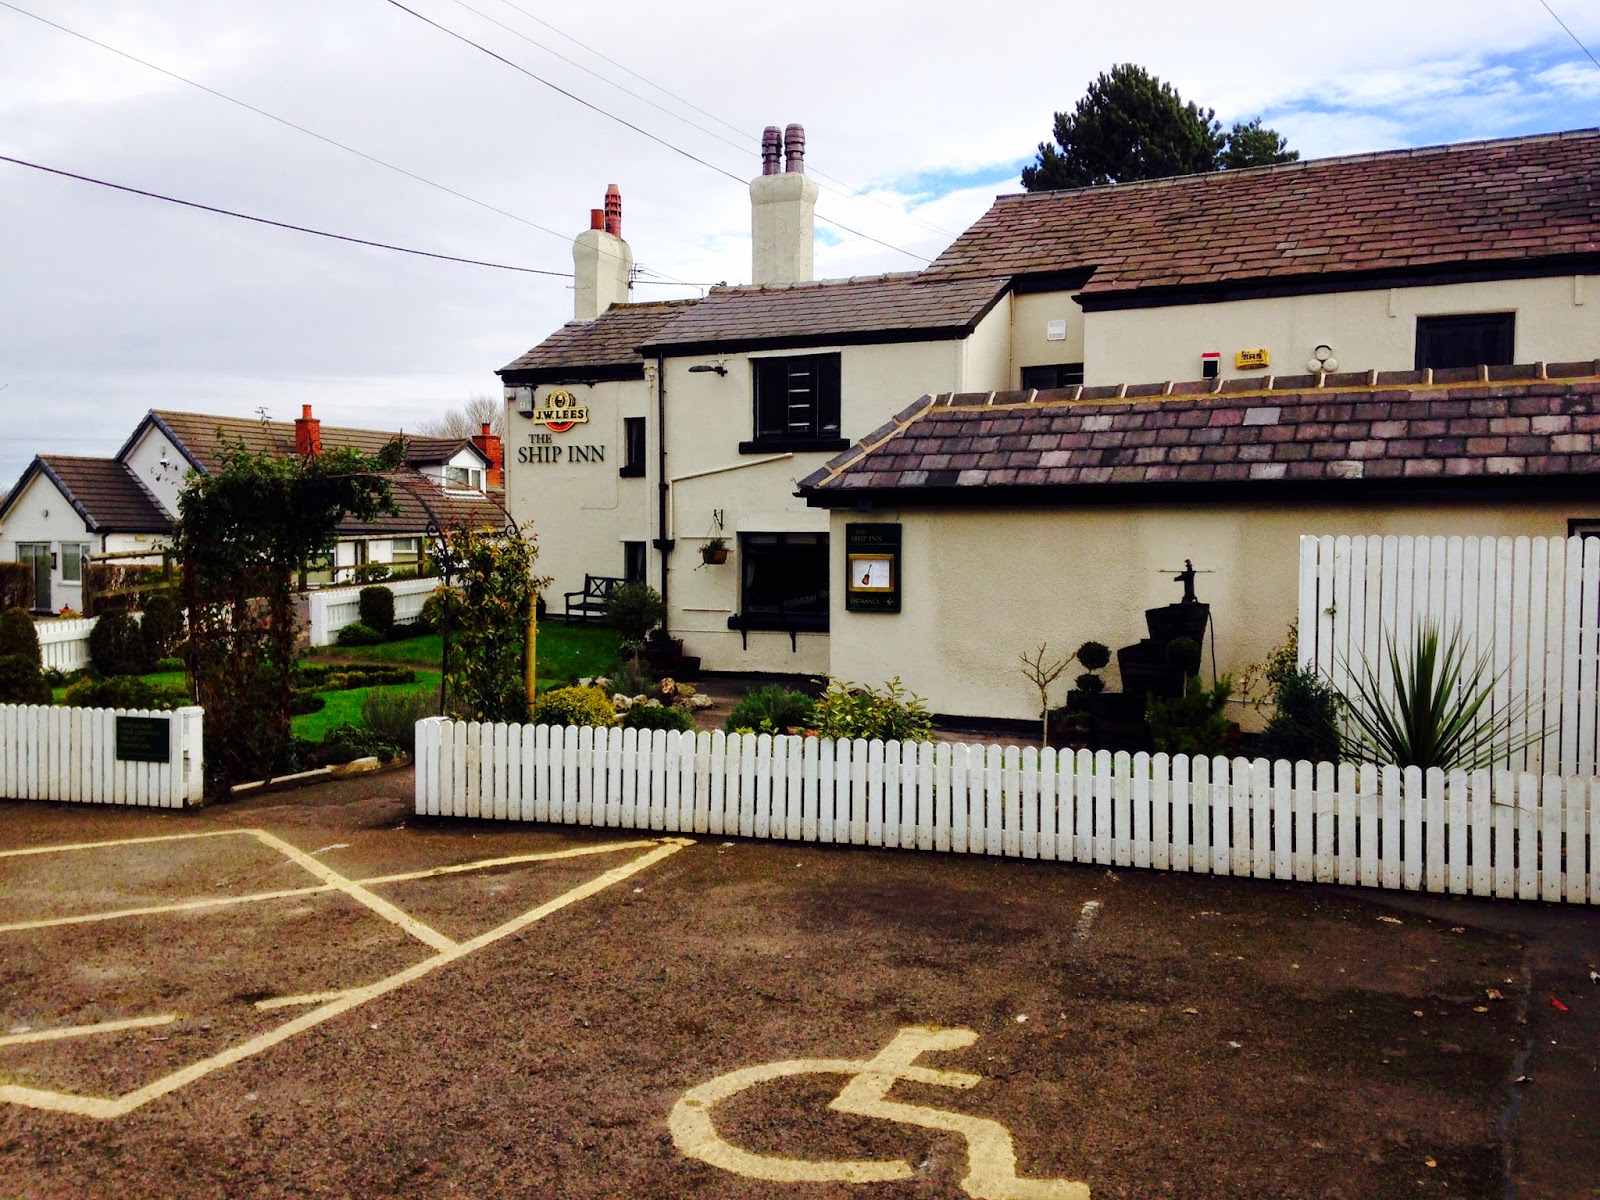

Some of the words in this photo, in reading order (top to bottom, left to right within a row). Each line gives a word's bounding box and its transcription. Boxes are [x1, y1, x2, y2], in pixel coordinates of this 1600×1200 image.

[528, 433, 552, 444] THE
[517, 446, 562, 463] SHIP
[567, 445, 605, 462] INN
